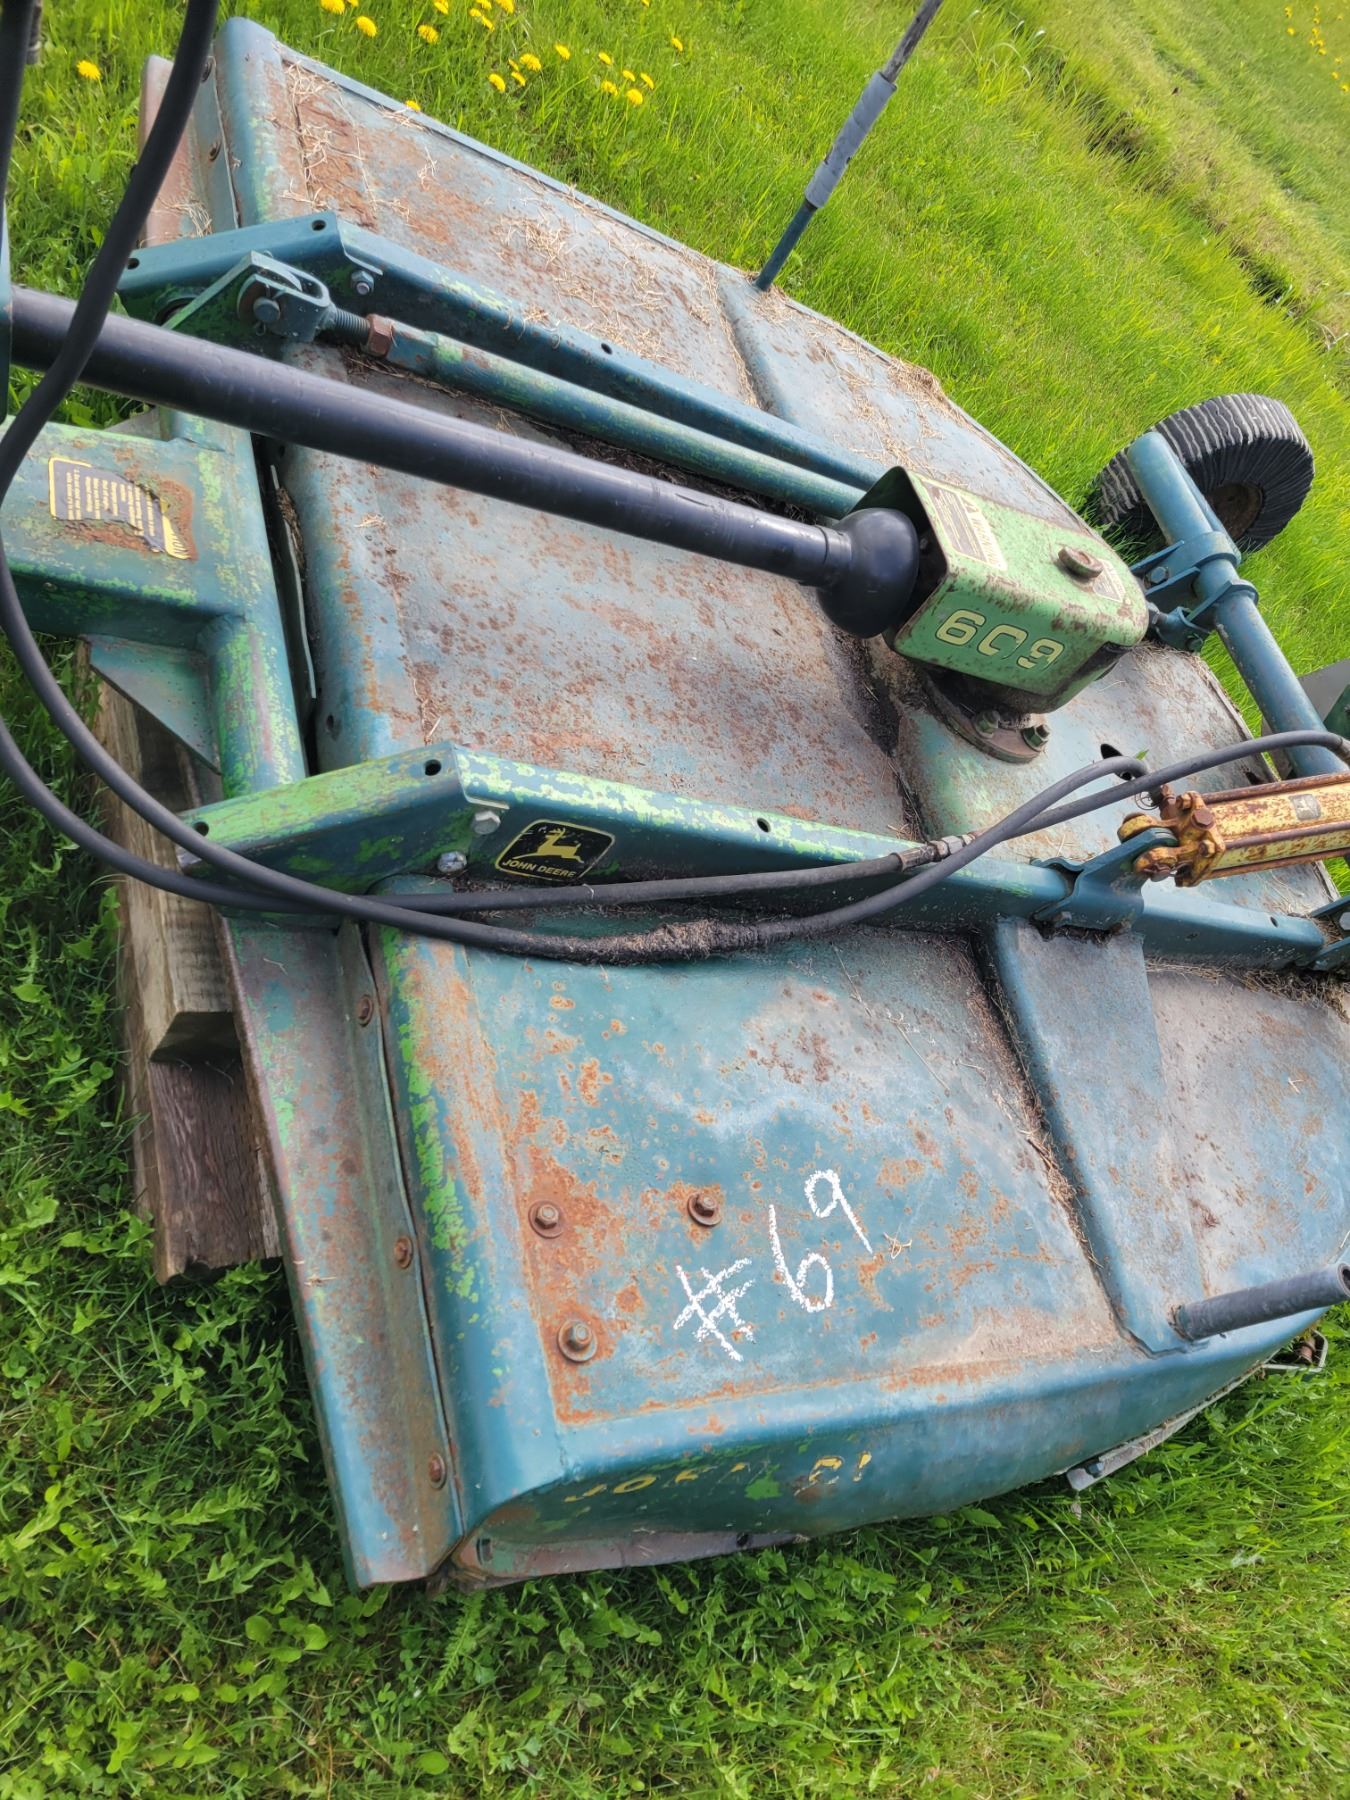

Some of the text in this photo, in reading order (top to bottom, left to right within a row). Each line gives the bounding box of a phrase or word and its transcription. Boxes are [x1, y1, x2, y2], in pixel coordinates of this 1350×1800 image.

[935, 609, 1064, 671] 609
[502, 859, 577, 878] JOHN DEERE
